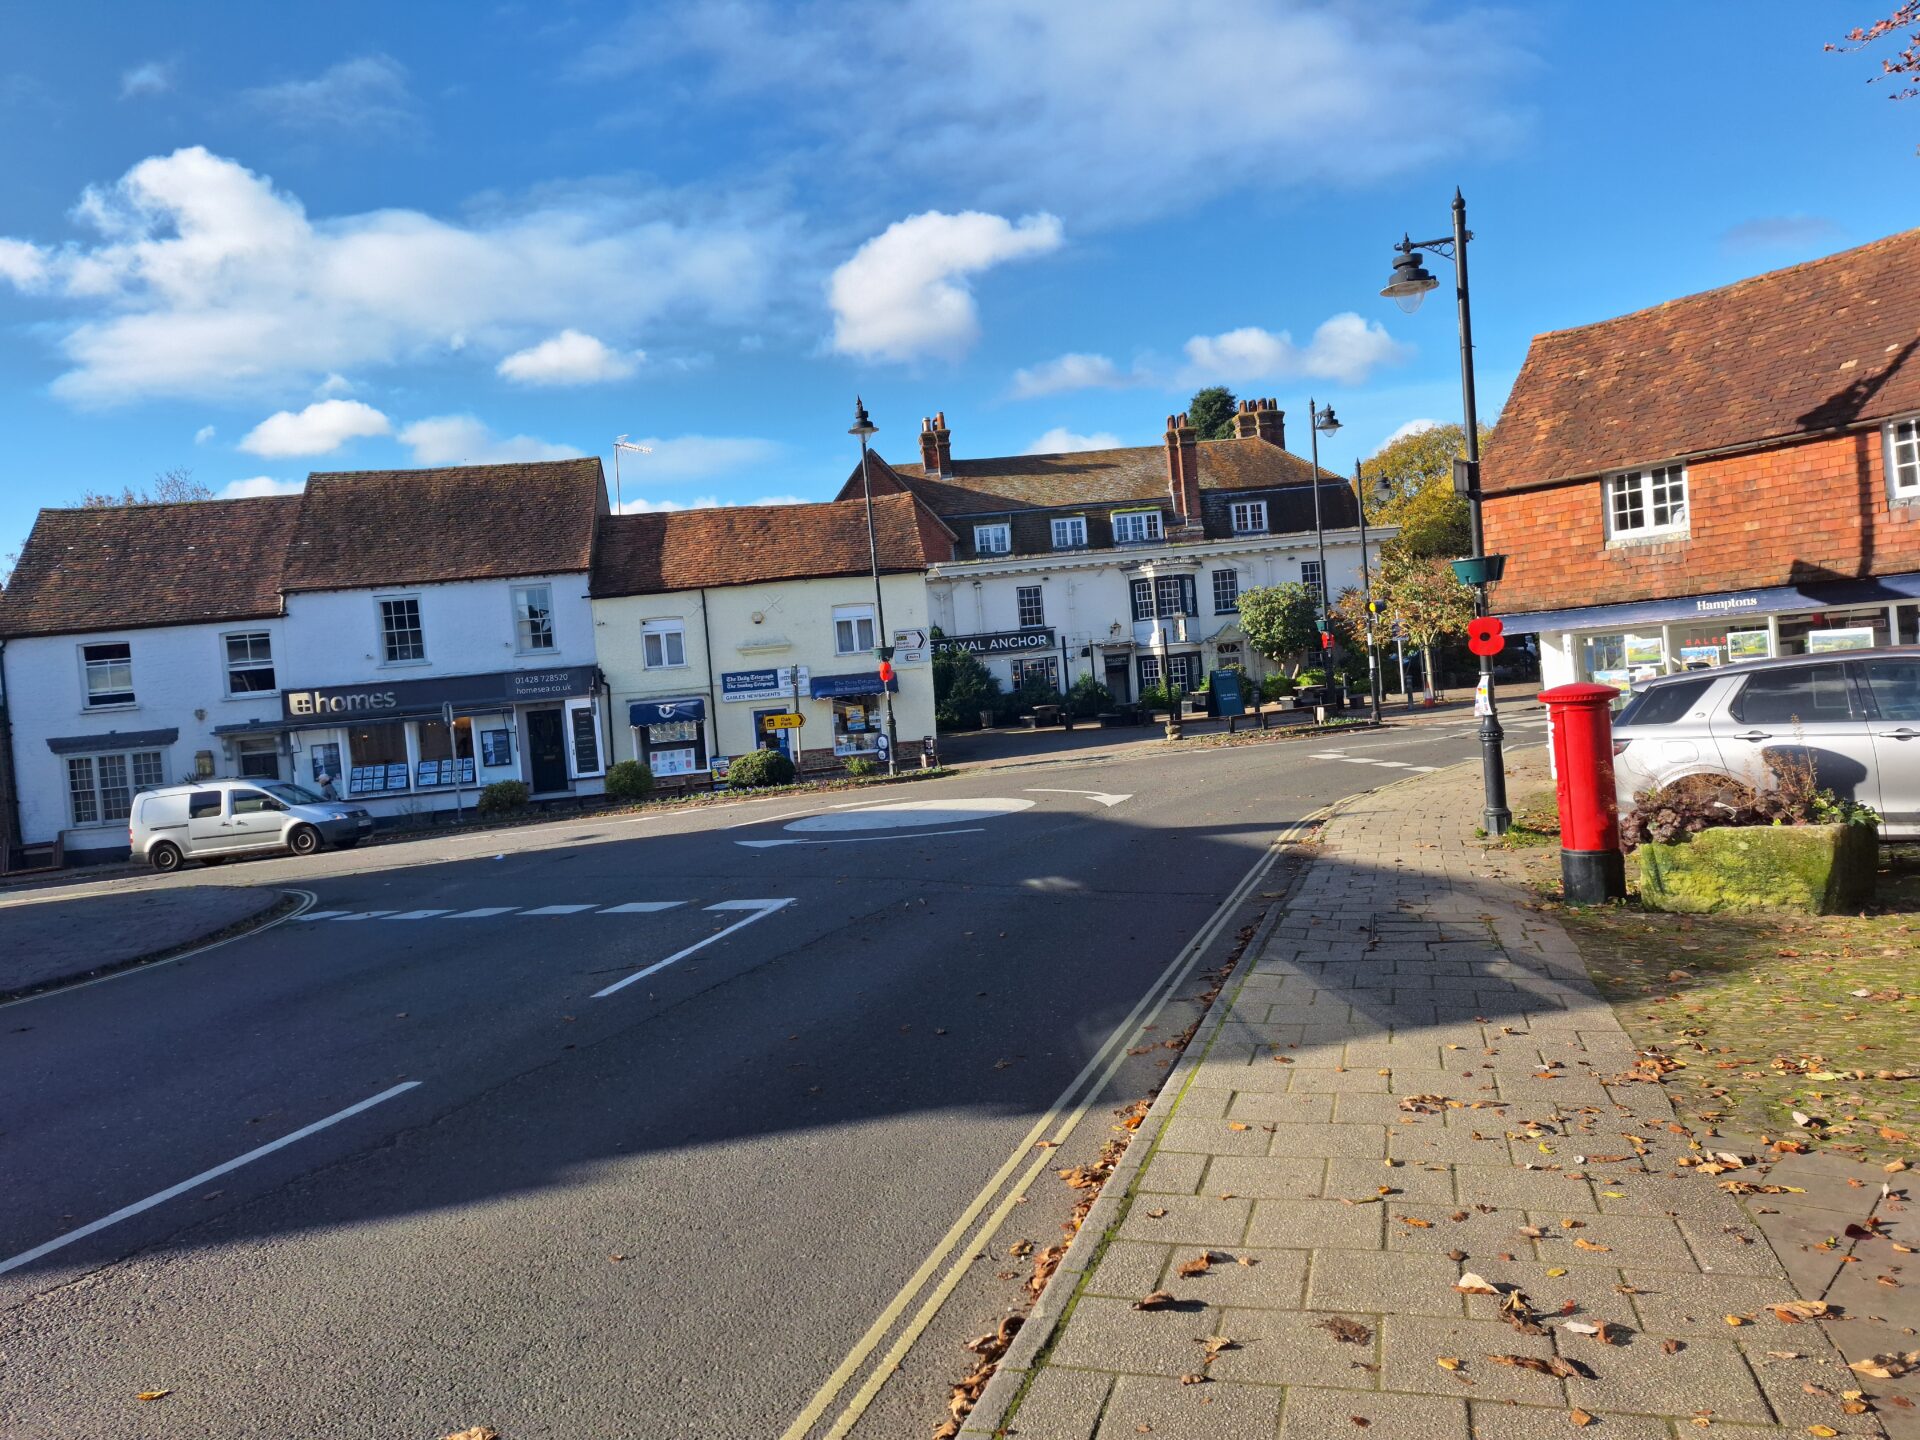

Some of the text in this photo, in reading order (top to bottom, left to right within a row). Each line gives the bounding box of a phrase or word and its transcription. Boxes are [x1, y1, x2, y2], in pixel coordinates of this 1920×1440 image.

[1696, 597, 1758, 610] Hamptons
[939, 641, 985, 654] ROYAL
[989, 634, 1048, 650] ANCHOR
[1685, 636, 1727, 646] SALES
[515, 673, 569, 685] 01428 728520
[750, 673, 775, 681] Telegraph
[516, 683, 572, 695] homesea.co.uk
[746, 691, 781, 699] NEWSAGENTS
[314, 690, 397, 715] homes
